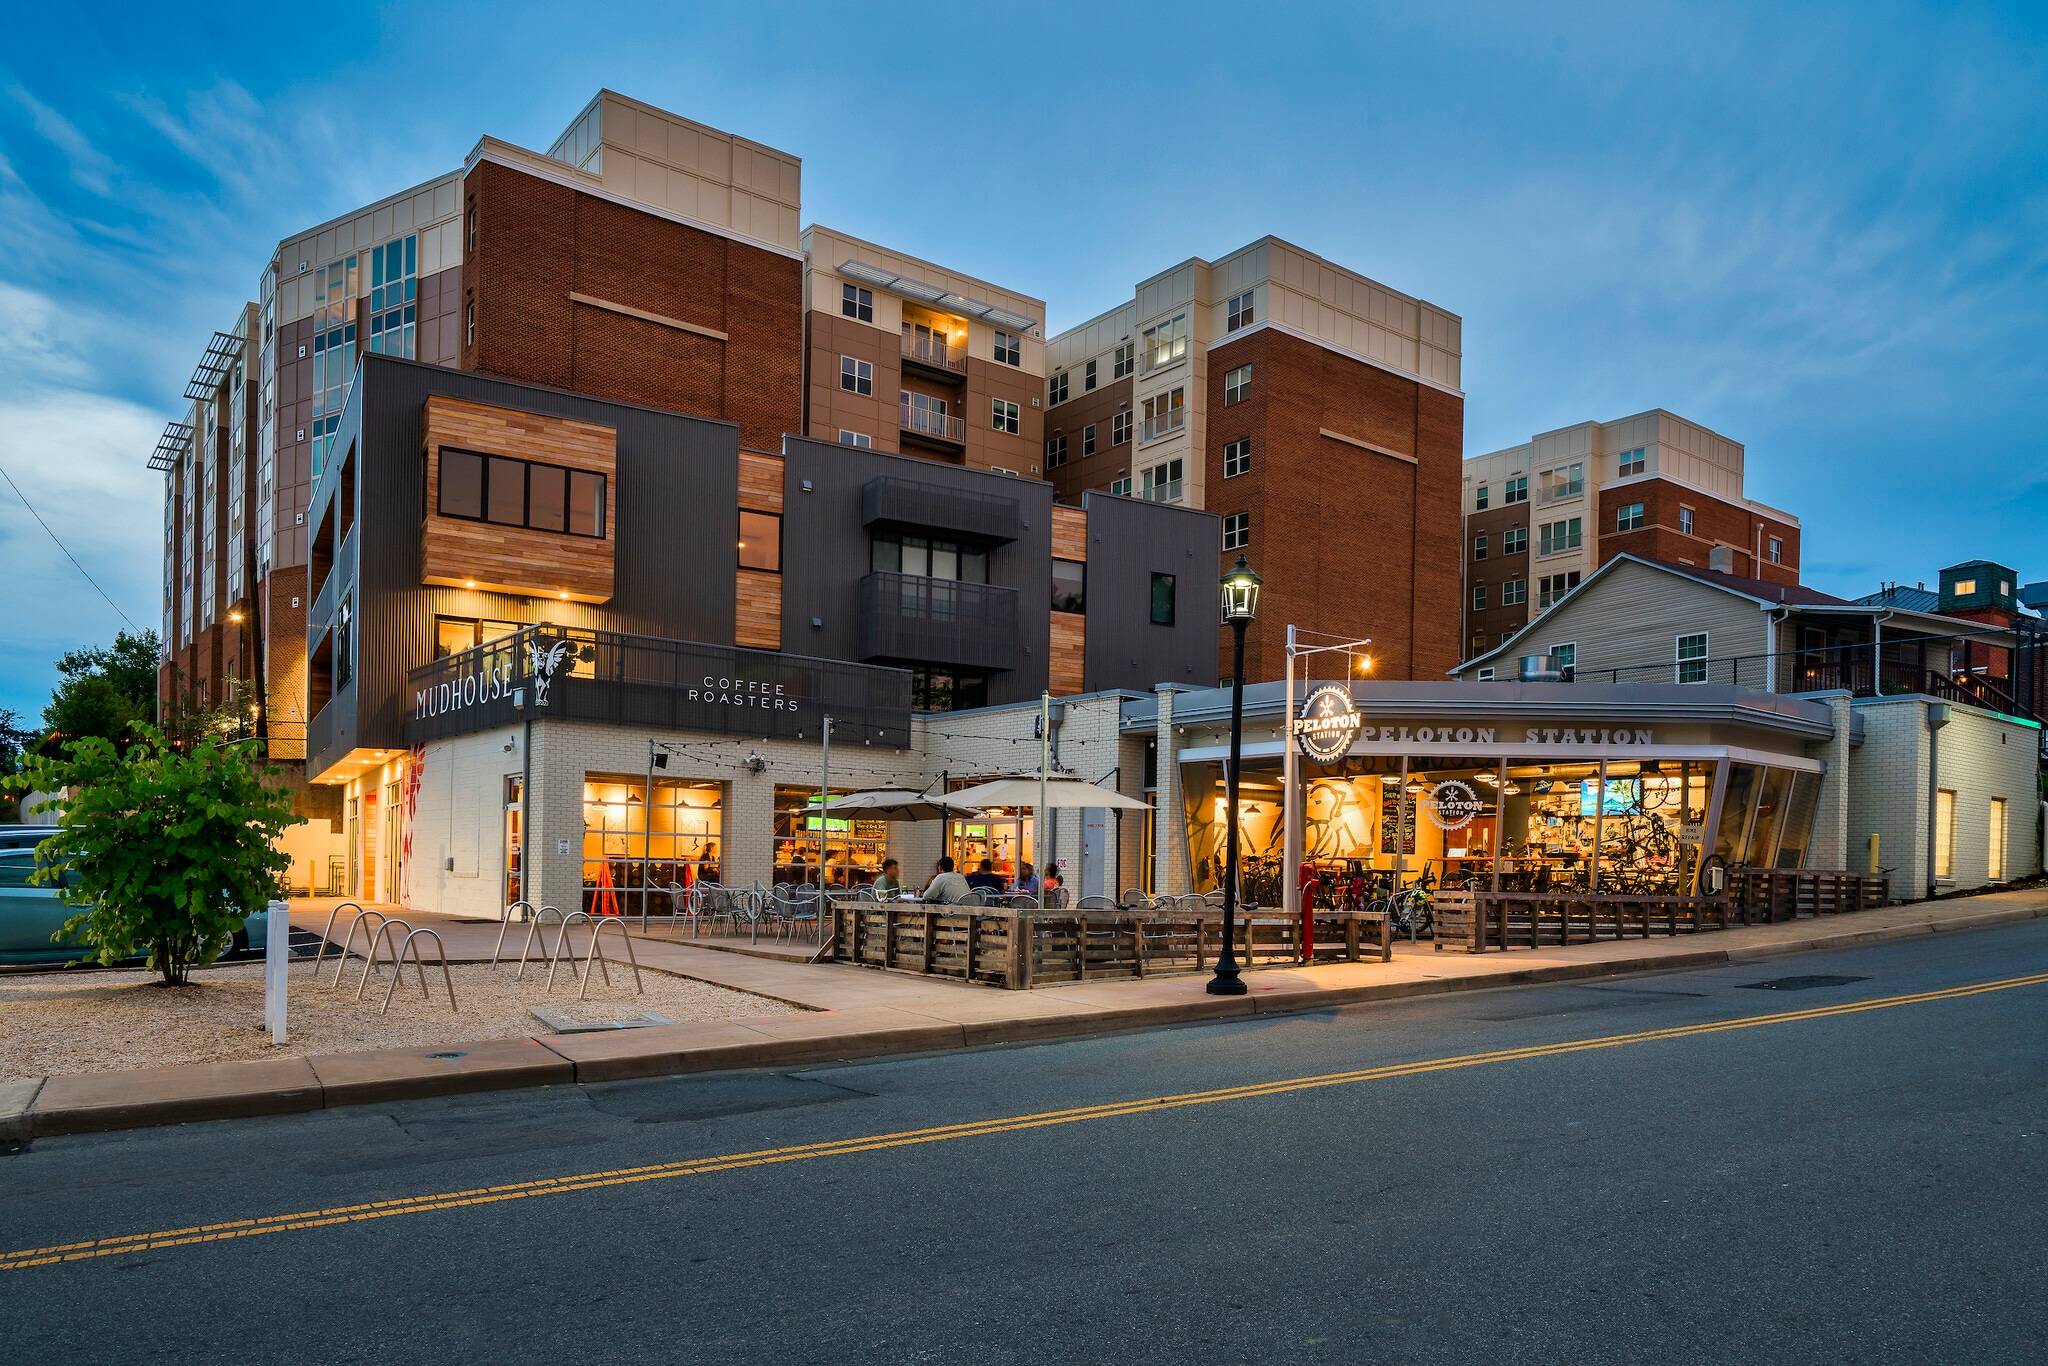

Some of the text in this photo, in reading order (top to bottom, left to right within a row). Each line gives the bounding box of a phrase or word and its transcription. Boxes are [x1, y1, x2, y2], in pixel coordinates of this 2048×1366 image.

[415, 663, 513, 721] MUDHOUSE
[703, 676, 784, 696] COFFEE
[688, 689, 798, 711] ROASTERS
[1293, 712, 1361, 735] PELOTON
[1312, 730, 1341, 740] STATION
[1358, 726, 1653, 745] PELOTON STATION
[1420, 800, 1483, 811] PELOTON
